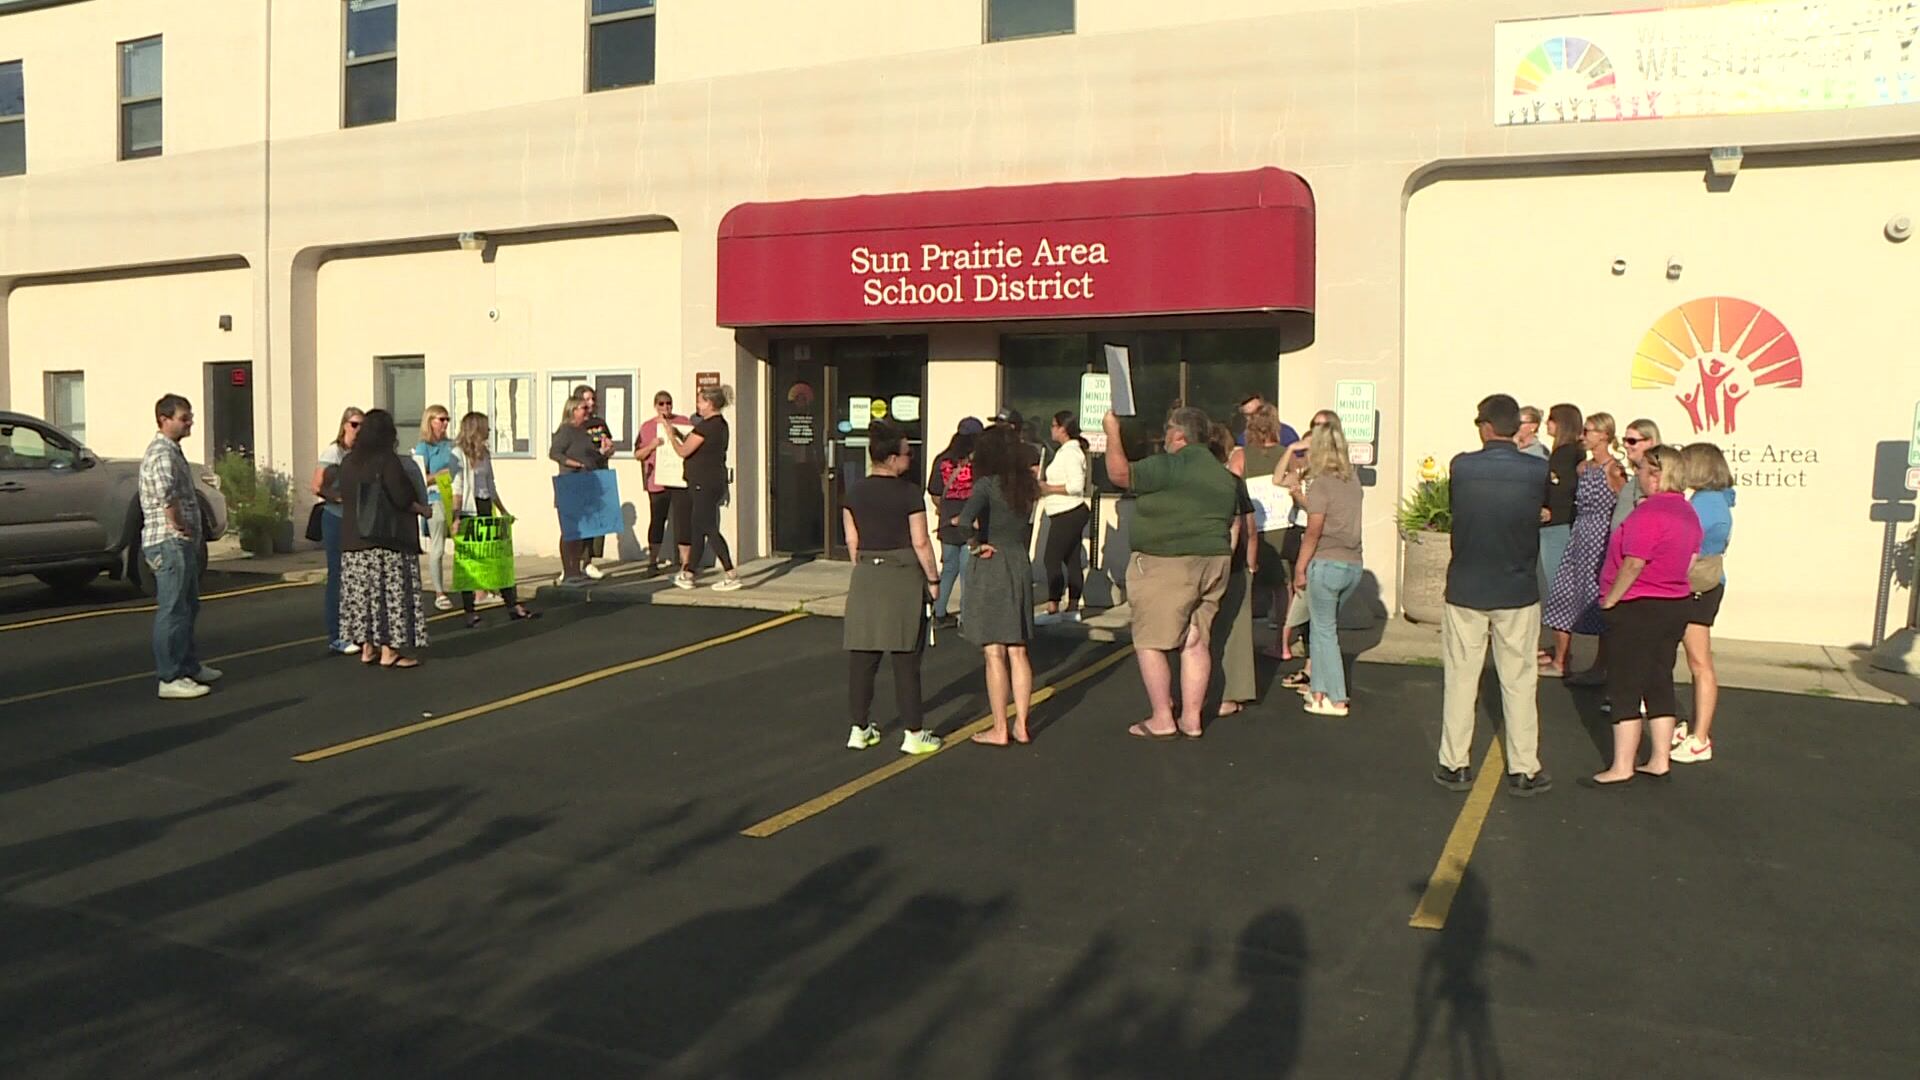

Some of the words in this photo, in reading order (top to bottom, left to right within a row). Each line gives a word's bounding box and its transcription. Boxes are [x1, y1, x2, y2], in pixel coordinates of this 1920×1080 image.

[850, 246, 911, 275] Sun
[920, 240, 1023, 272] Prairie
[1031, 237, 1109, 267] Area
[863, 274, 964, 306] School
[973, 271, 1095, 303] District
[1095, 379, 1106, 389] 30
[1085, 391, 1109, 401] MINUT
[1350, 386, 1362, 396] 30
[1085, 404, 1109, 414] VISITO
[1339, 399, 1371, 410] MINUTE
[1083, 417, 1103, 426] PARK
[1343, 427, 1371, 437] ARKING
[1760, 444, 1819, 464] Area
[1733, 468, 1808, 487] istrict
